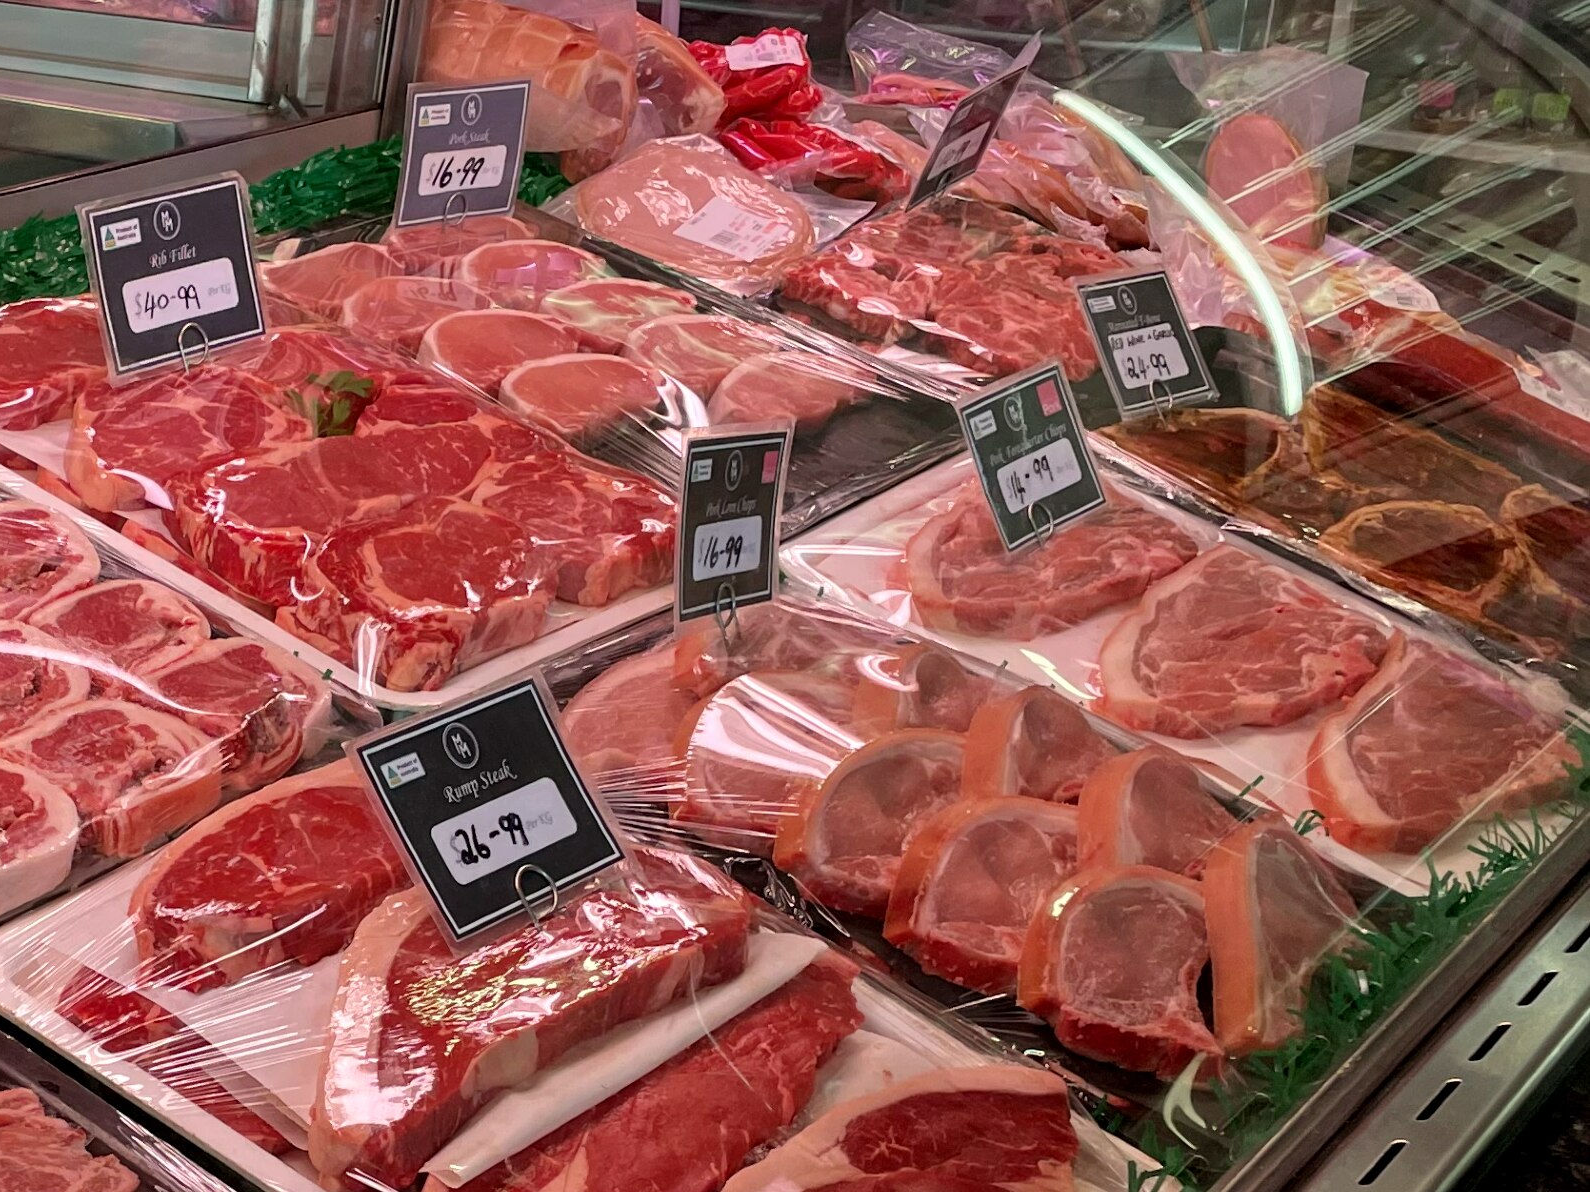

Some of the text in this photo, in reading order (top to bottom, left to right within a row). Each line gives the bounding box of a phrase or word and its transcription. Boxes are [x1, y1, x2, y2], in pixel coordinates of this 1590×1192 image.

[149, 243, 197, 269] Rib Fillet
[443, 758, 518, 803] Rump Steak
